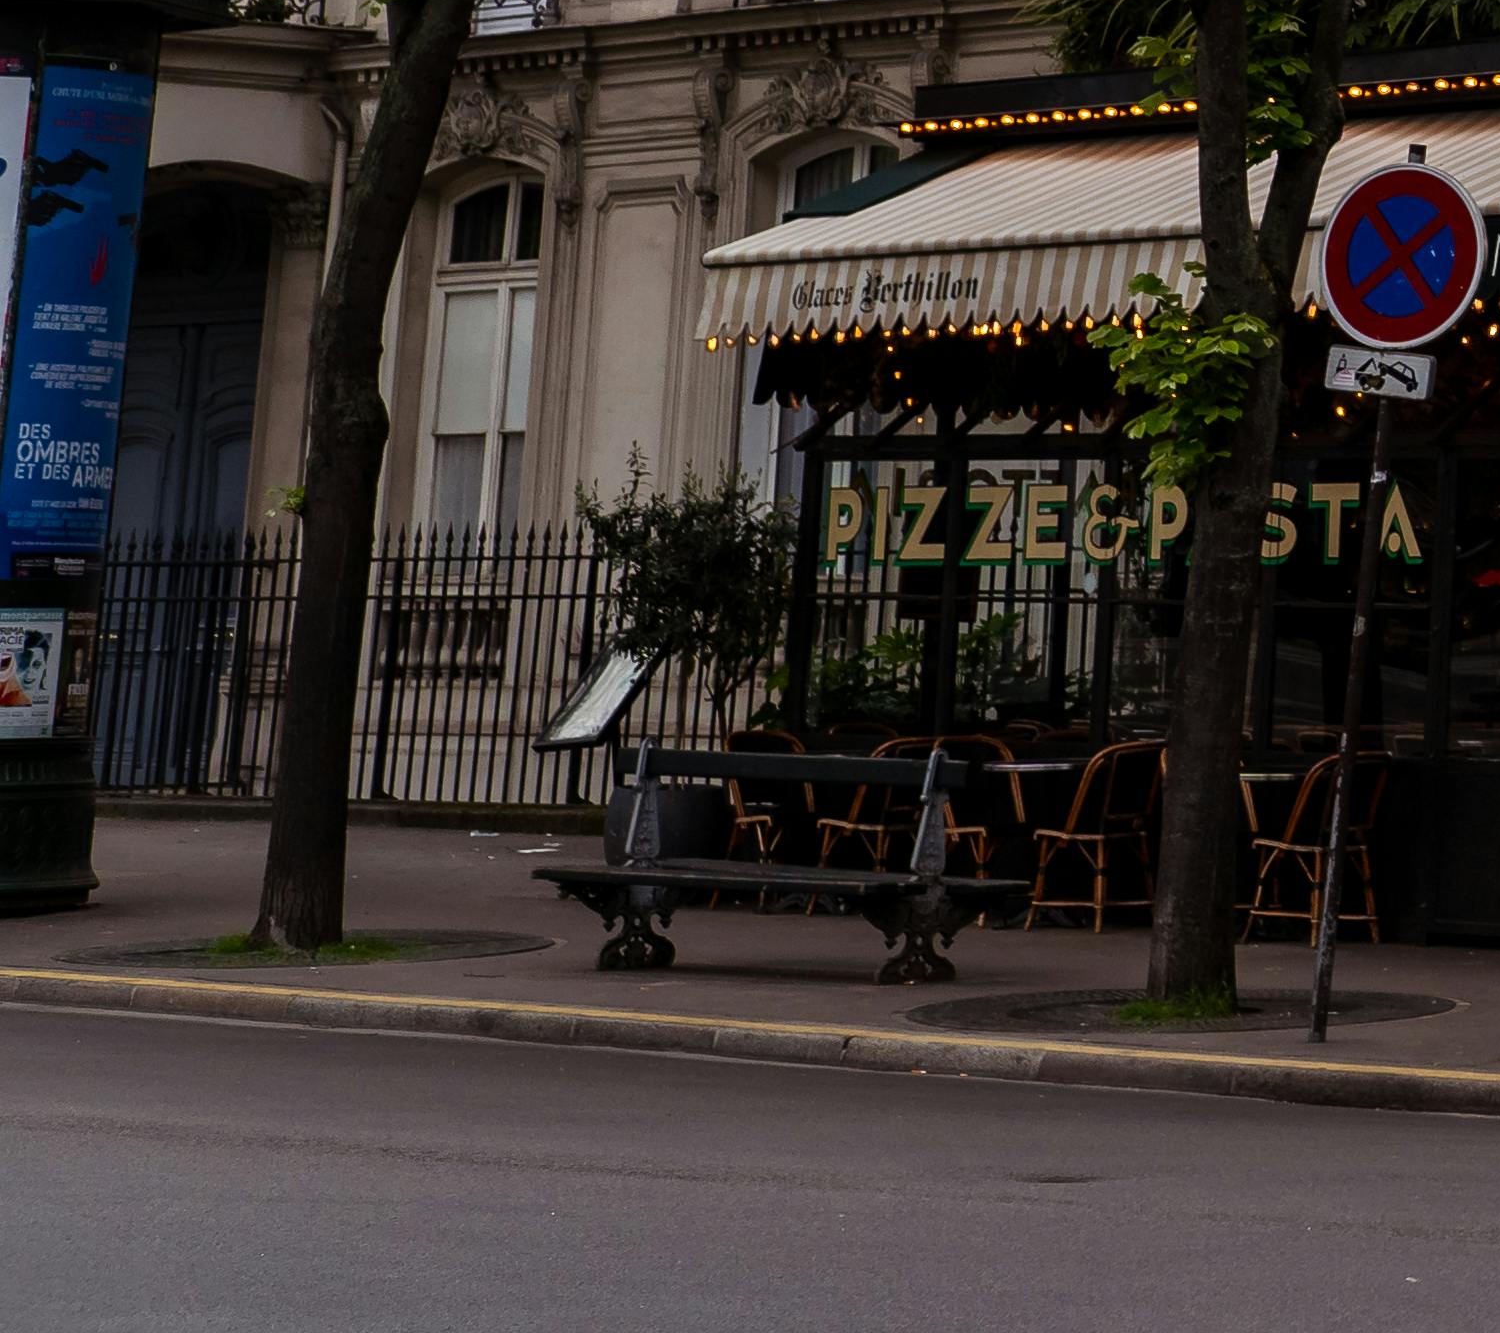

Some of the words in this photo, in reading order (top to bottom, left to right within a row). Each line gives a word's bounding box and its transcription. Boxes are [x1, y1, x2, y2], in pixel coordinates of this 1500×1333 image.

[792, 279, 853, 311] Glaces
[859, 269, 979, 313] Berthillon
[18, 423, 52, 440] DES
[16, 439, 101, 465] OMBRES
[14, 463, 37, 480] ET
[41, 464, 71, 481] DES
